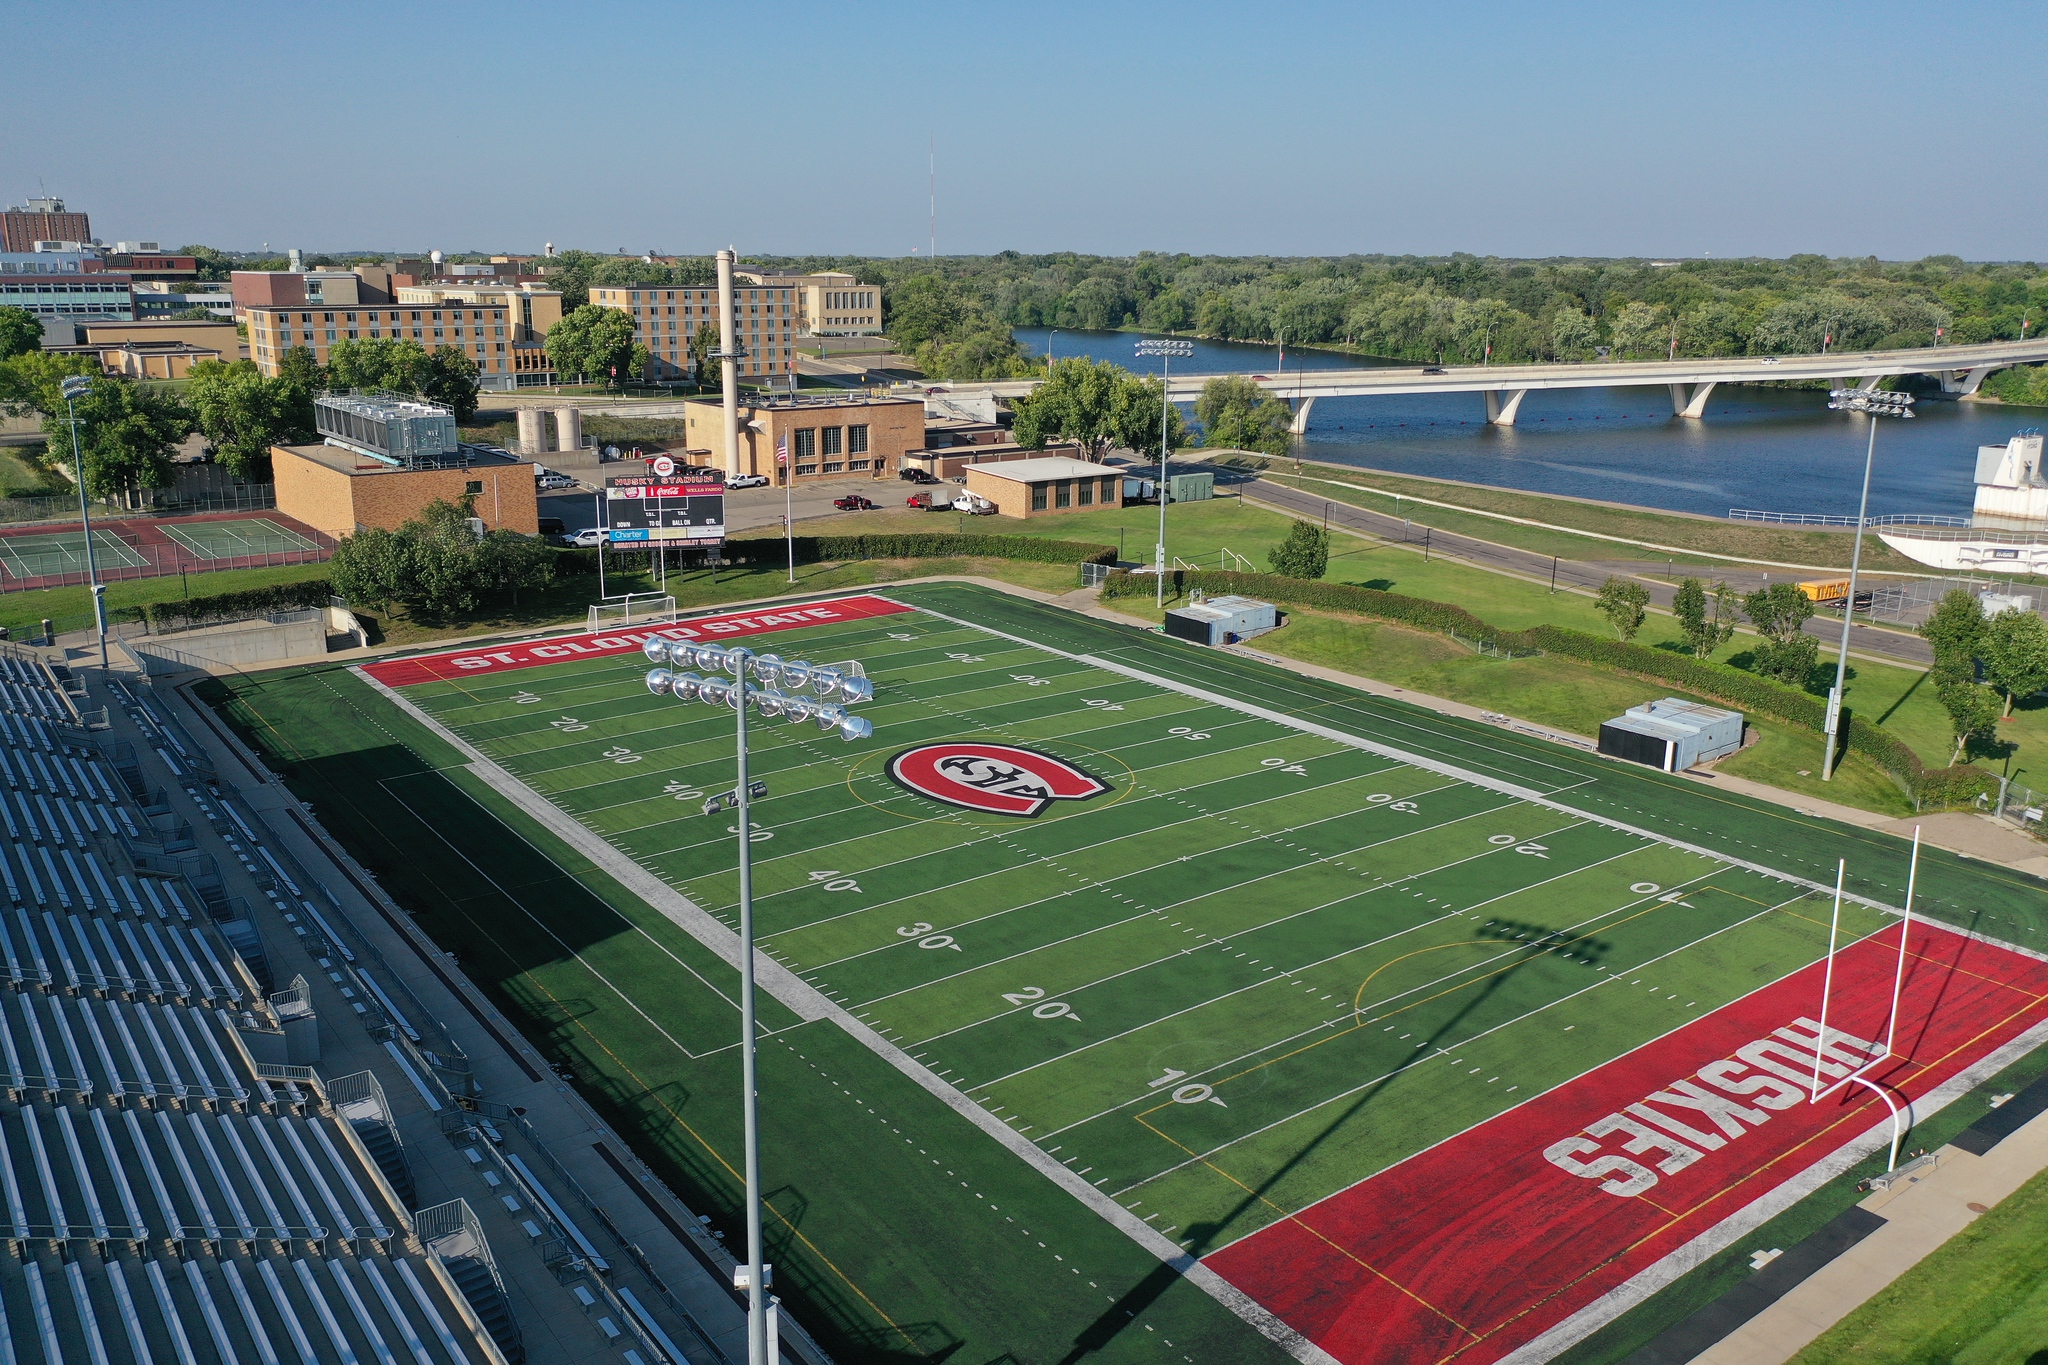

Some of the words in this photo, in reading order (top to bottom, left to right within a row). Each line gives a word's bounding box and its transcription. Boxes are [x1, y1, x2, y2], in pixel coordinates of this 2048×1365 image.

[615, 478, 655, 486] HUSKY
[661, 476, 714, 484] STADIUM
[657, 487, 680, 496] Coca-Cola
[614, 530, 643, 538] Charter
[450, 652, 529, 669] ST.
[530, 627, 702, 659] CLOUD
[701, 607, 842, 633] STATE
[891, 633, 919, 642] 10
[948, 652, 985, 663] 20
[1014, 674, 1051, 686] 30
[509, 691, 542, 704] 10
[1086, 698, 1125, 711] 40
[550, 717, 589, 732] 20
[1167, 726, 1212, 742] 50
[603, 747, 643, 764] 30
[1260, 758, 1307, 773] 40
[663, 784, 704, 800] 40
[1365, 793, 1418, 814] 30
[727, 822, 775, 842] 50
[1487, 834, 1549, 856] 20
[808, 869, 857, 892] 40
[1629, 882, 1684, 904] 10
[896, 922, 954, 950] 30
[1001, 986, 1071, 1019] 20
[1147, 1067, 1213, 1104] 10
[1542, 1016, 1890, 1198] HUSKIES
